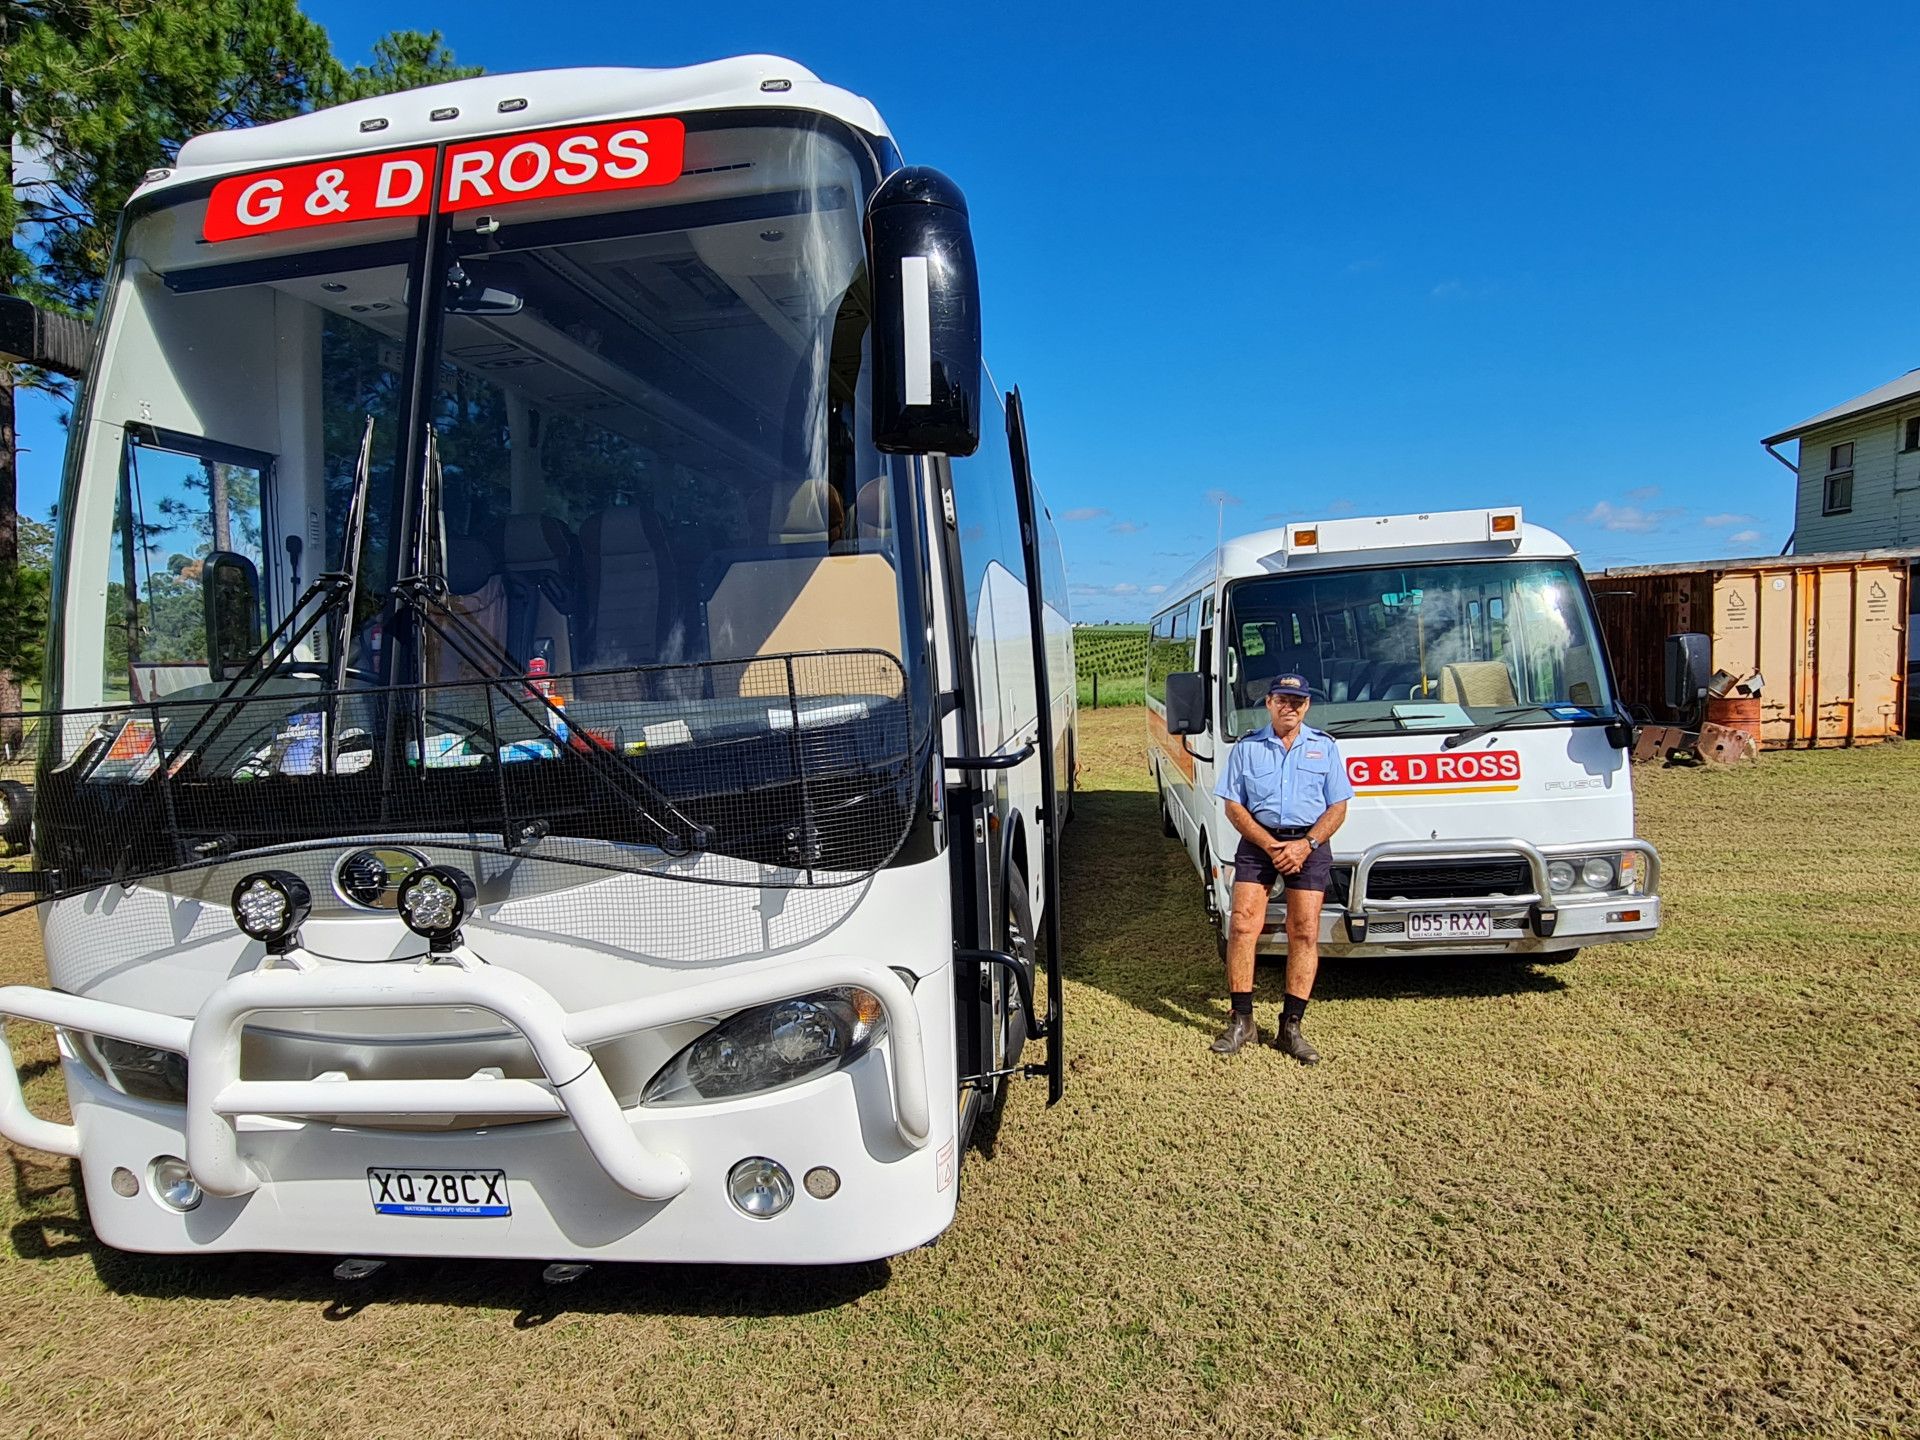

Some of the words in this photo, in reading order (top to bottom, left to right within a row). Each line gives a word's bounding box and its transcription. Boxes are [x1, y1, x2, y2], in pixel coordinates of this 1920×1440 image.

[236, 178, 283, 226] G
[304, 168, 350, 216] &
[375, 160, 424, 208] D
[448, 129, 650, 202] ROSS
[1349, 761, 1369, 783] G
[1379, 760, 1399, 782] &
[1408, 759, 1427, 780] D
[1437, 754, 1518, 779] ROSS
